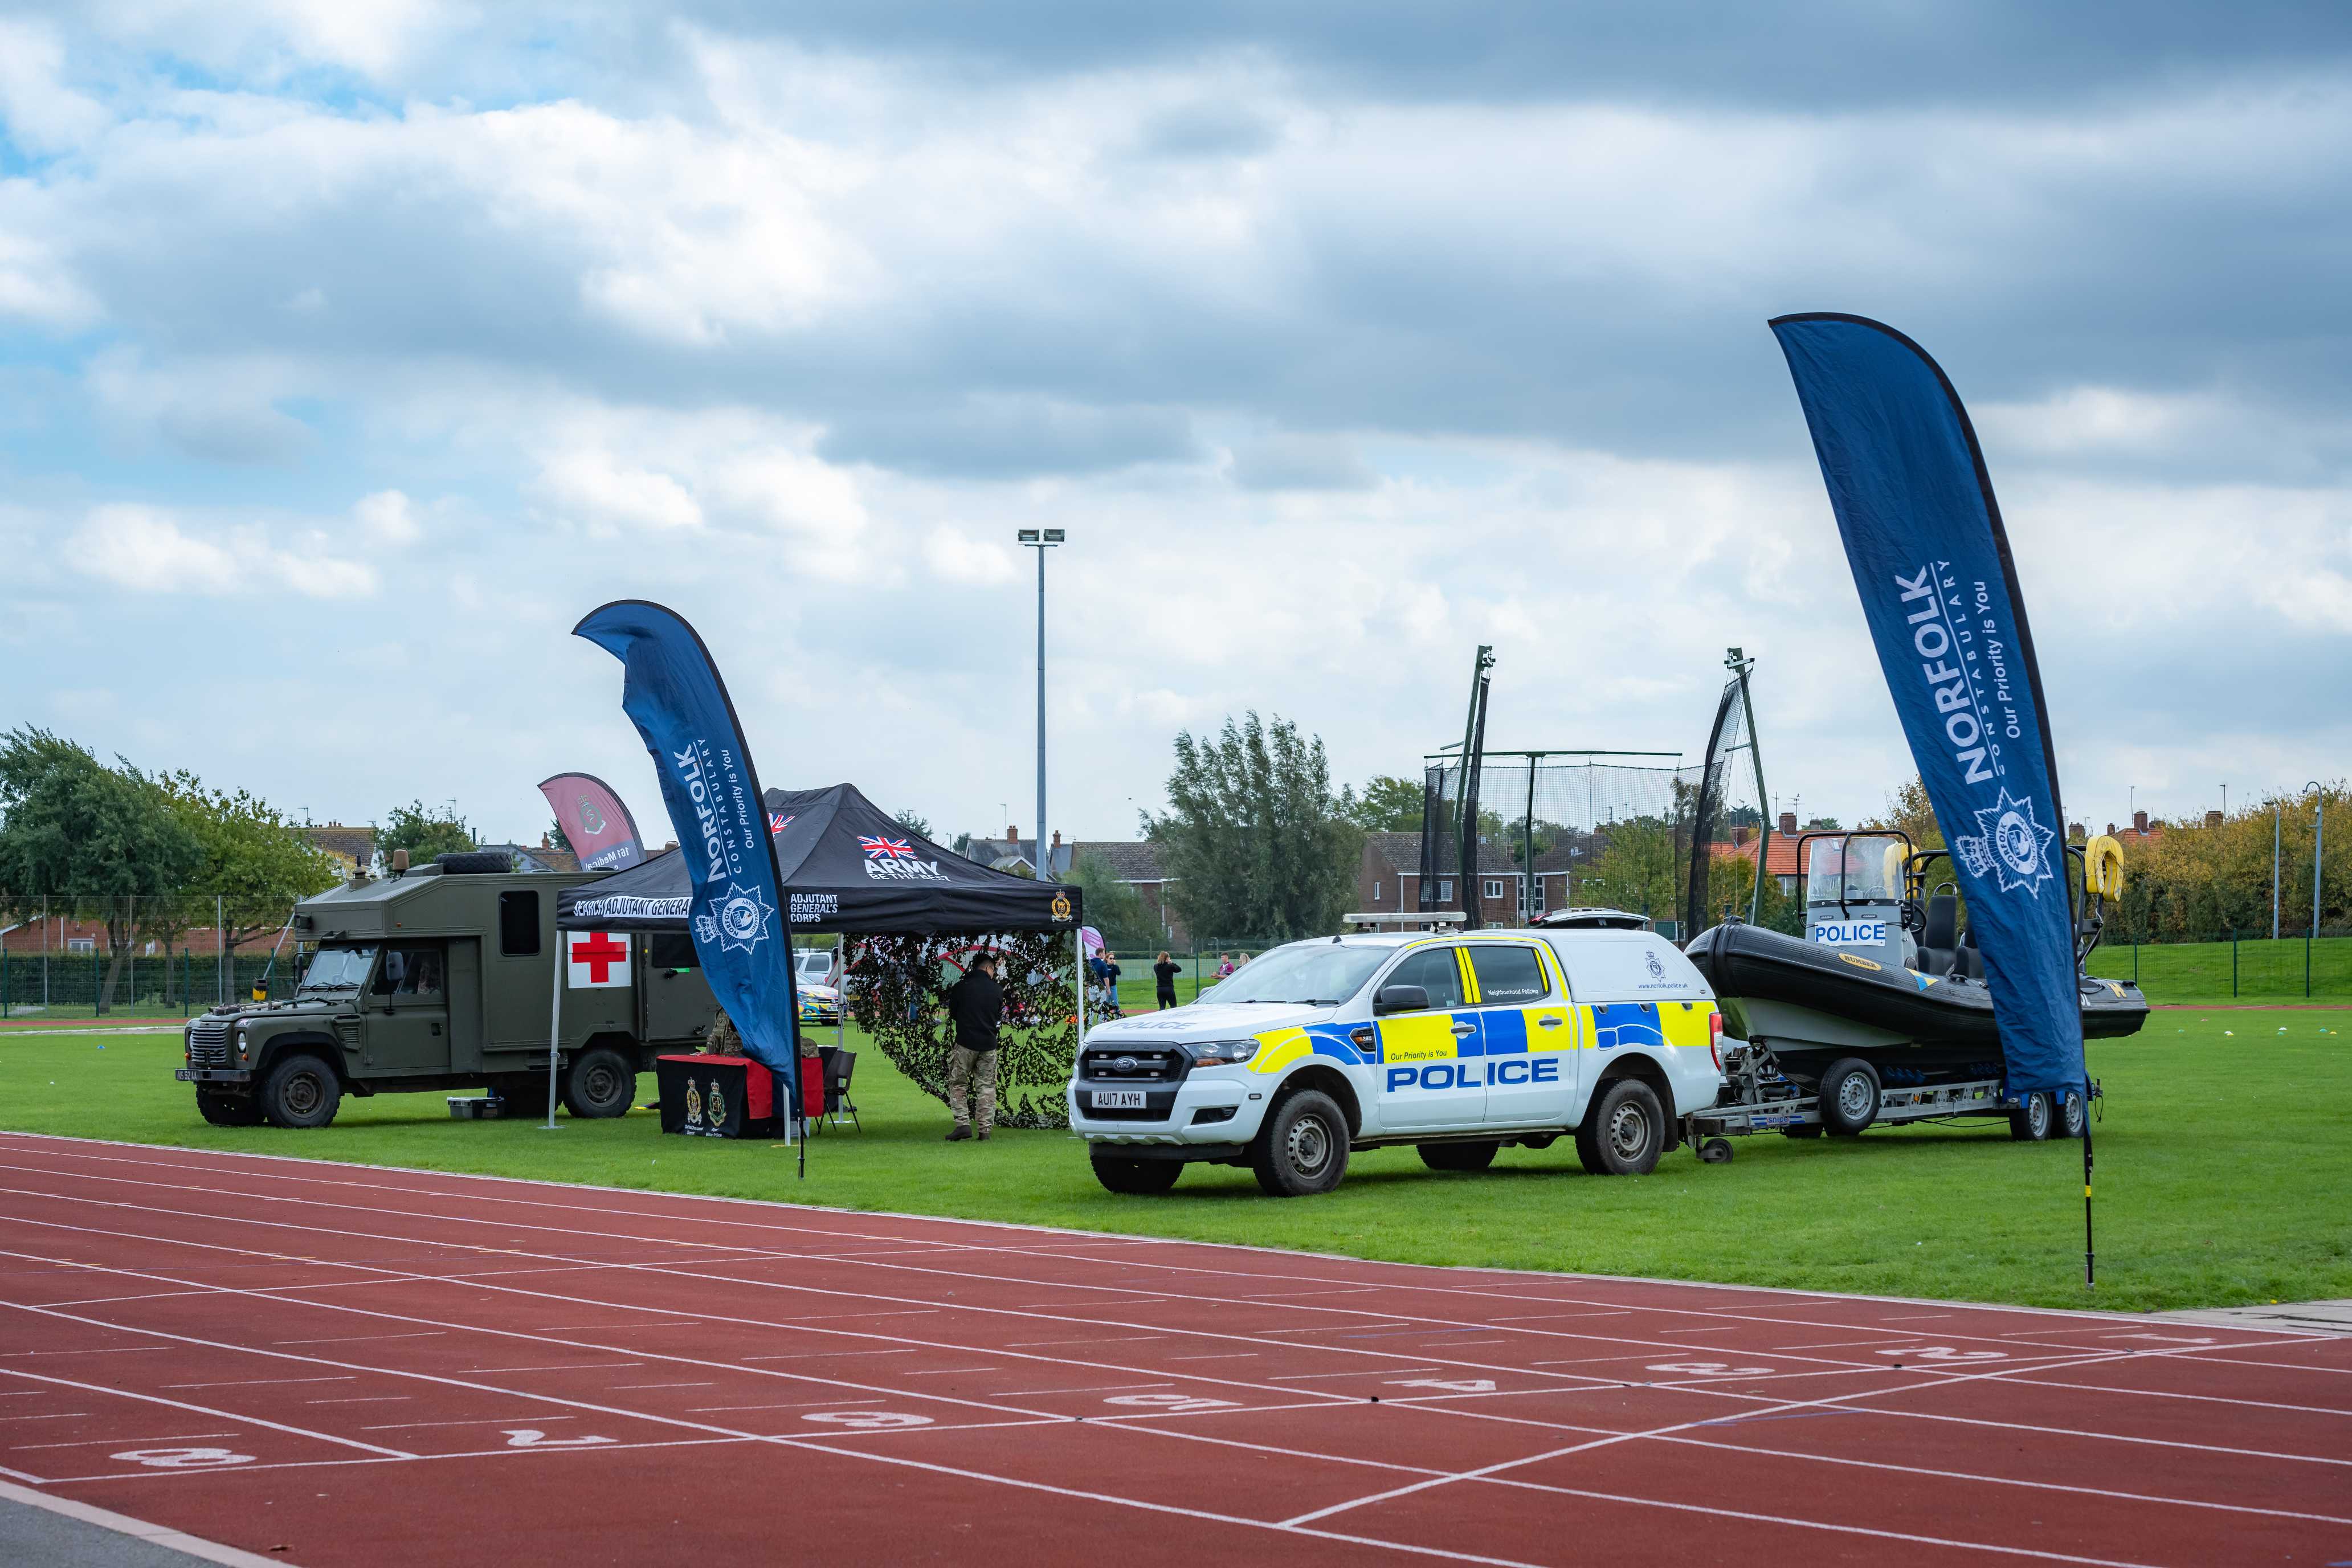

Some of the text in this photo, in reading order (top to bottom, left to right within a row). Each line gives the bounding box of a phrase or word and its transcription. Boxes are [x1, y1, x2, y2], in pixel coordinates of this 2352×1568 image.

[1937, 560, 2005, 775] CONSTABULARY
[1974, 581, 2020, 738] Our Priority is You
[1894, 565, 1993, 785] NORFOLK
[697, 739, 742, 873] CONSTABULARY
[721, 750, 754, 848] Our Priority is You
[673, 743, 726, 883] NORFOLK
[1999, 822, 2019, 869] NORFOLK
[864, 859, 941, 876] ARMY
[573, 899, 605, 916] SEARCH
[606, 897, 653, 915] ADJUTANT
[790, 893, 838, 903] ADJUTANT
[790, 903, 838, 913] GENERAL'S
[724, 906, 739, 937] NORFOLK
[742, 899, 758, 935] CONSTABULARY
[790, 913, 821, 922] CORPS
[1816, 924, 1886, 942] POLICE
[1844, 955, 1877, 969] HUMBER
[1106, 1021, 1198, 1030] POLICE
[1404, 1051, 1426, 1060] Priority
[1387, 1058, 1559, 1093] POLICE
[1098, 1093, 1140, 1106] AU17 AYH
[2099, 1334, 2218, 1344] 1
[1875, 1346, 2009, 1360] 2
[1644, 1362, 1775, 1376] 3
[1381, 1379, 1497, 1392] 4
[1103, 1394, 1244, 1411] 5
[801, 1411, 934, 1428] 6
[500, 1430, 619, 1447] 7
[109, 1448, 256, 1467] 8
